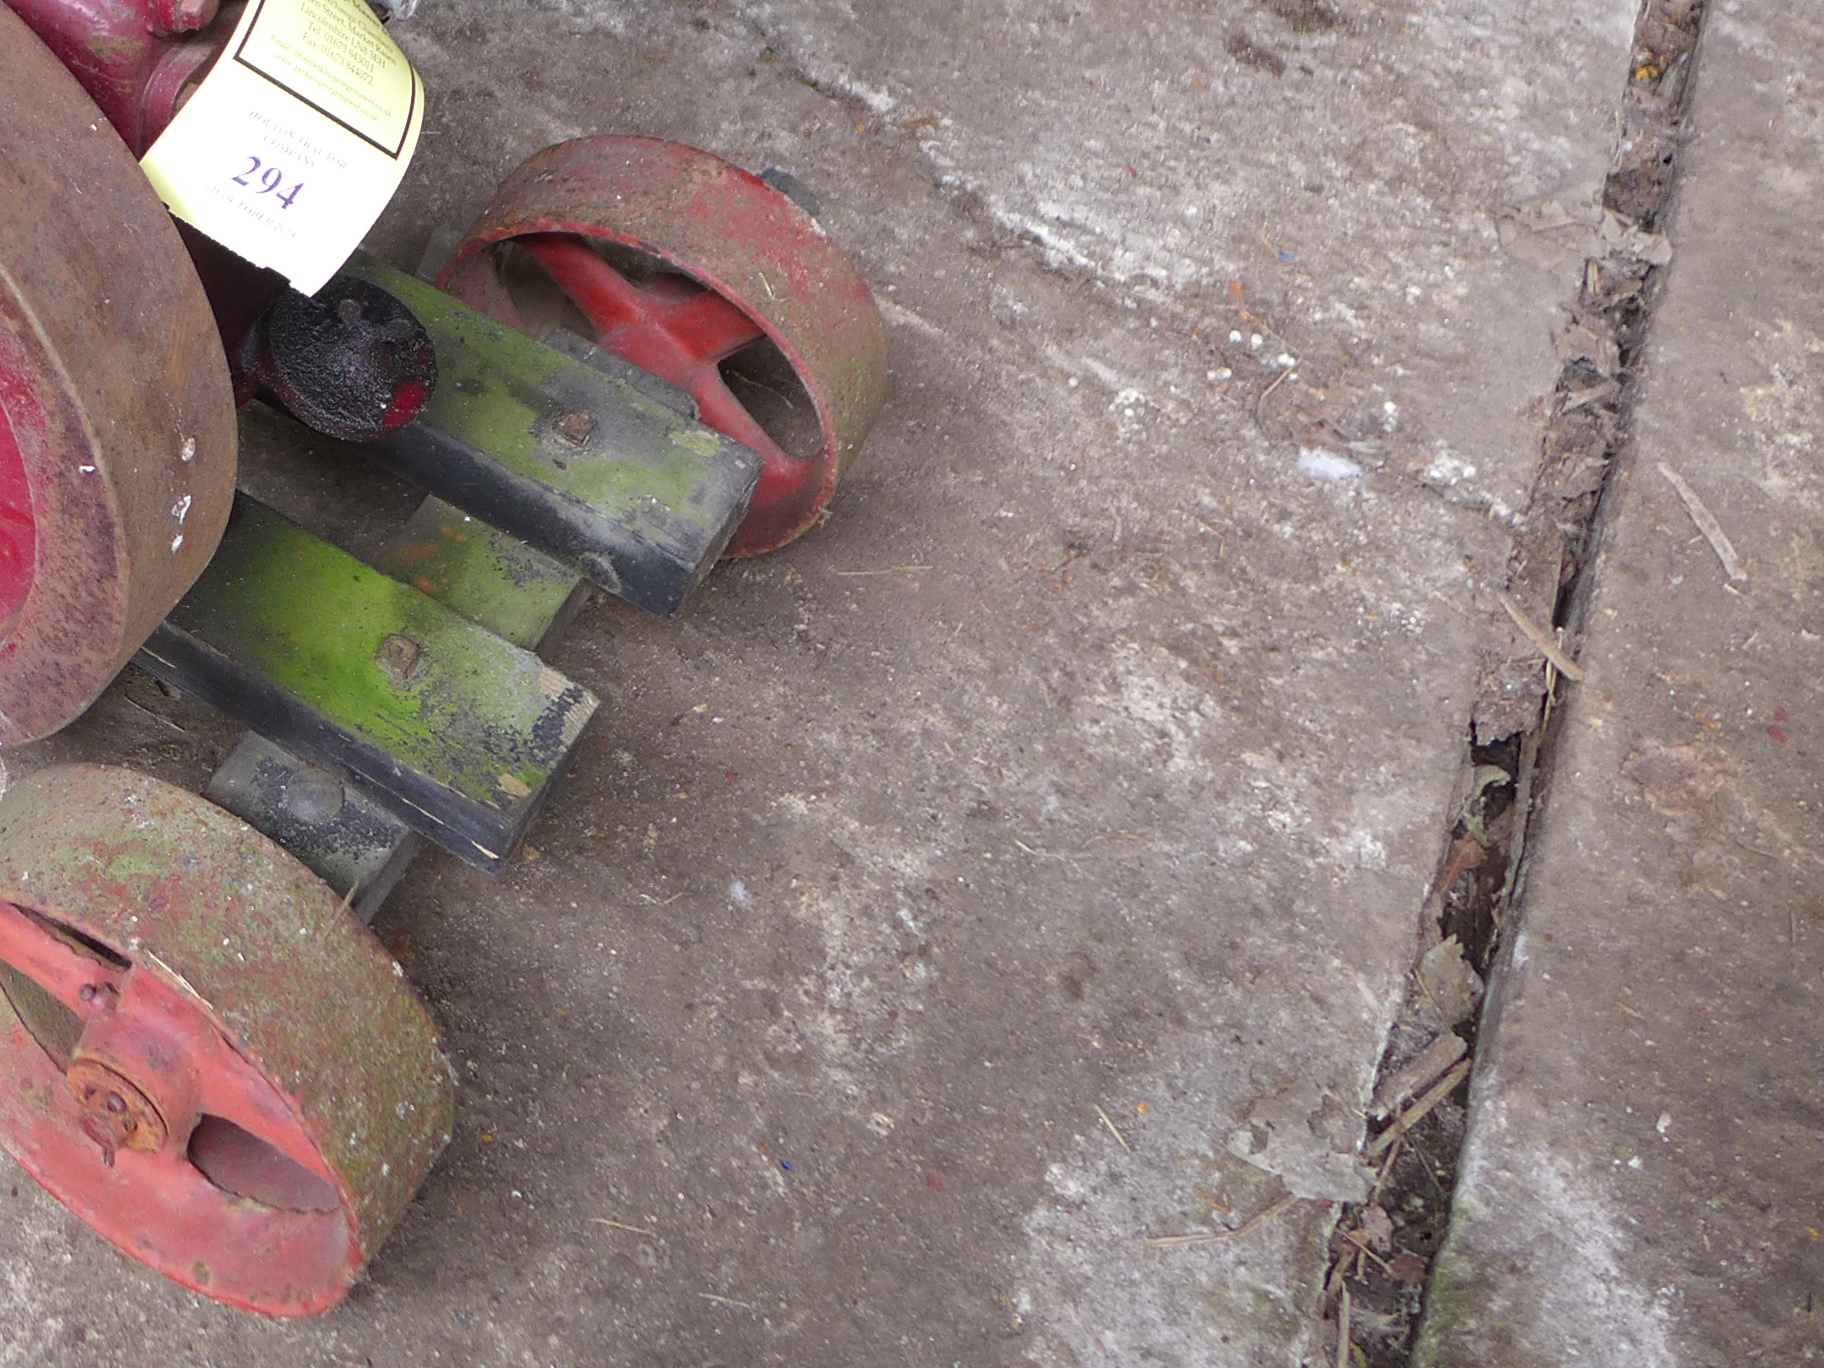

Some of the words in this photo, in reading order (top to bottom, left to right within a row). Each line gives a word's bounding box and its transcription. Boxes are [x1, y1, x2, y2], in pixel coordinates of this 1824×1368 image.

[301, 2, 351, 45] Lincolnshire
[324, 31, 347, 55] 01673
[230, 155, 304, 210] 294
